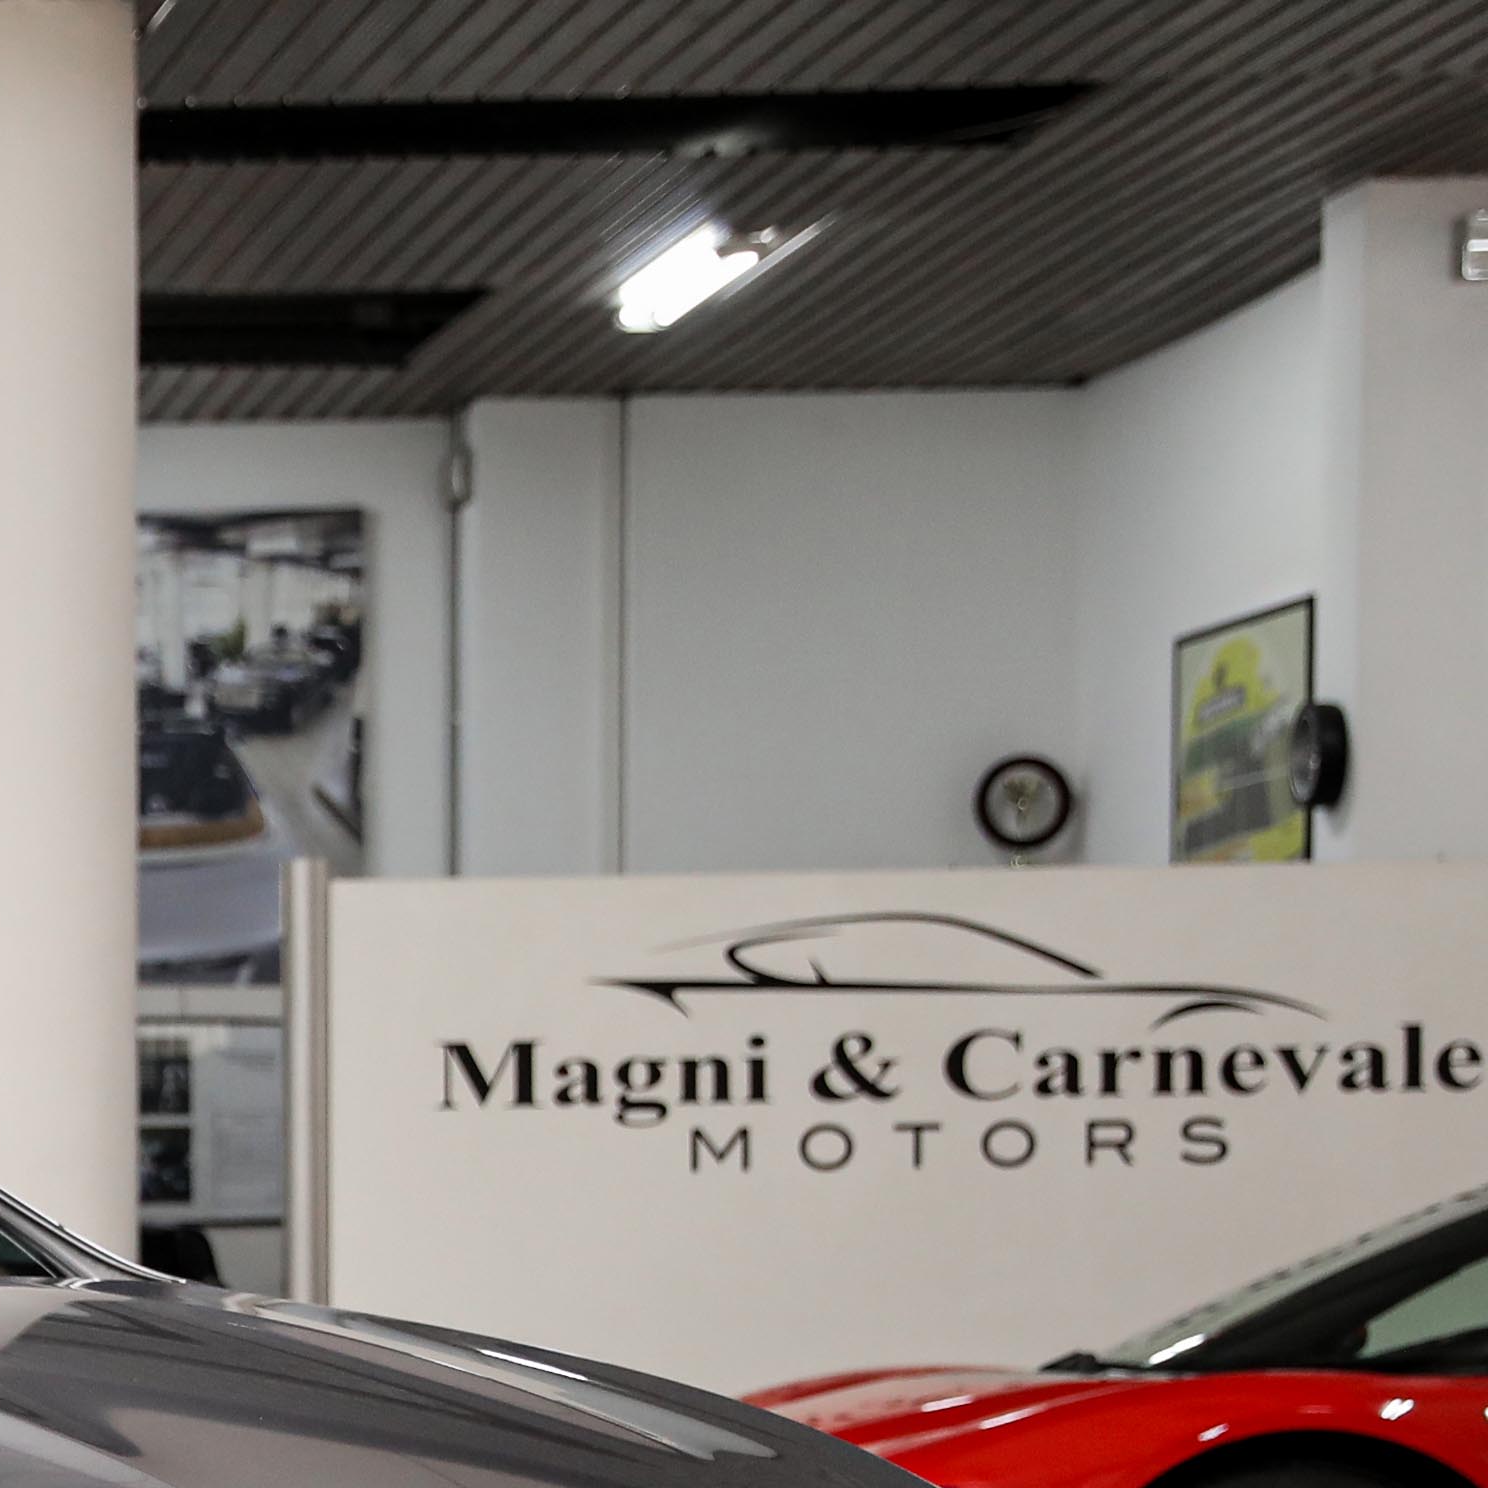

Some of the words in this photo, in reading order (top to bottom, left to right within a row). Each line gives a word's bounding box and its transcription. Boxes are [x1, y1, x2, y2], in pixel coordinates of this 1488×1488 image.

[437, 1034, 770, 1129] Magni
[810, 1031, 902, 1101] &
[941, 1022, 1483, 1101] Carnevale
[688, 1115, 1230, 1173] MOTORS
